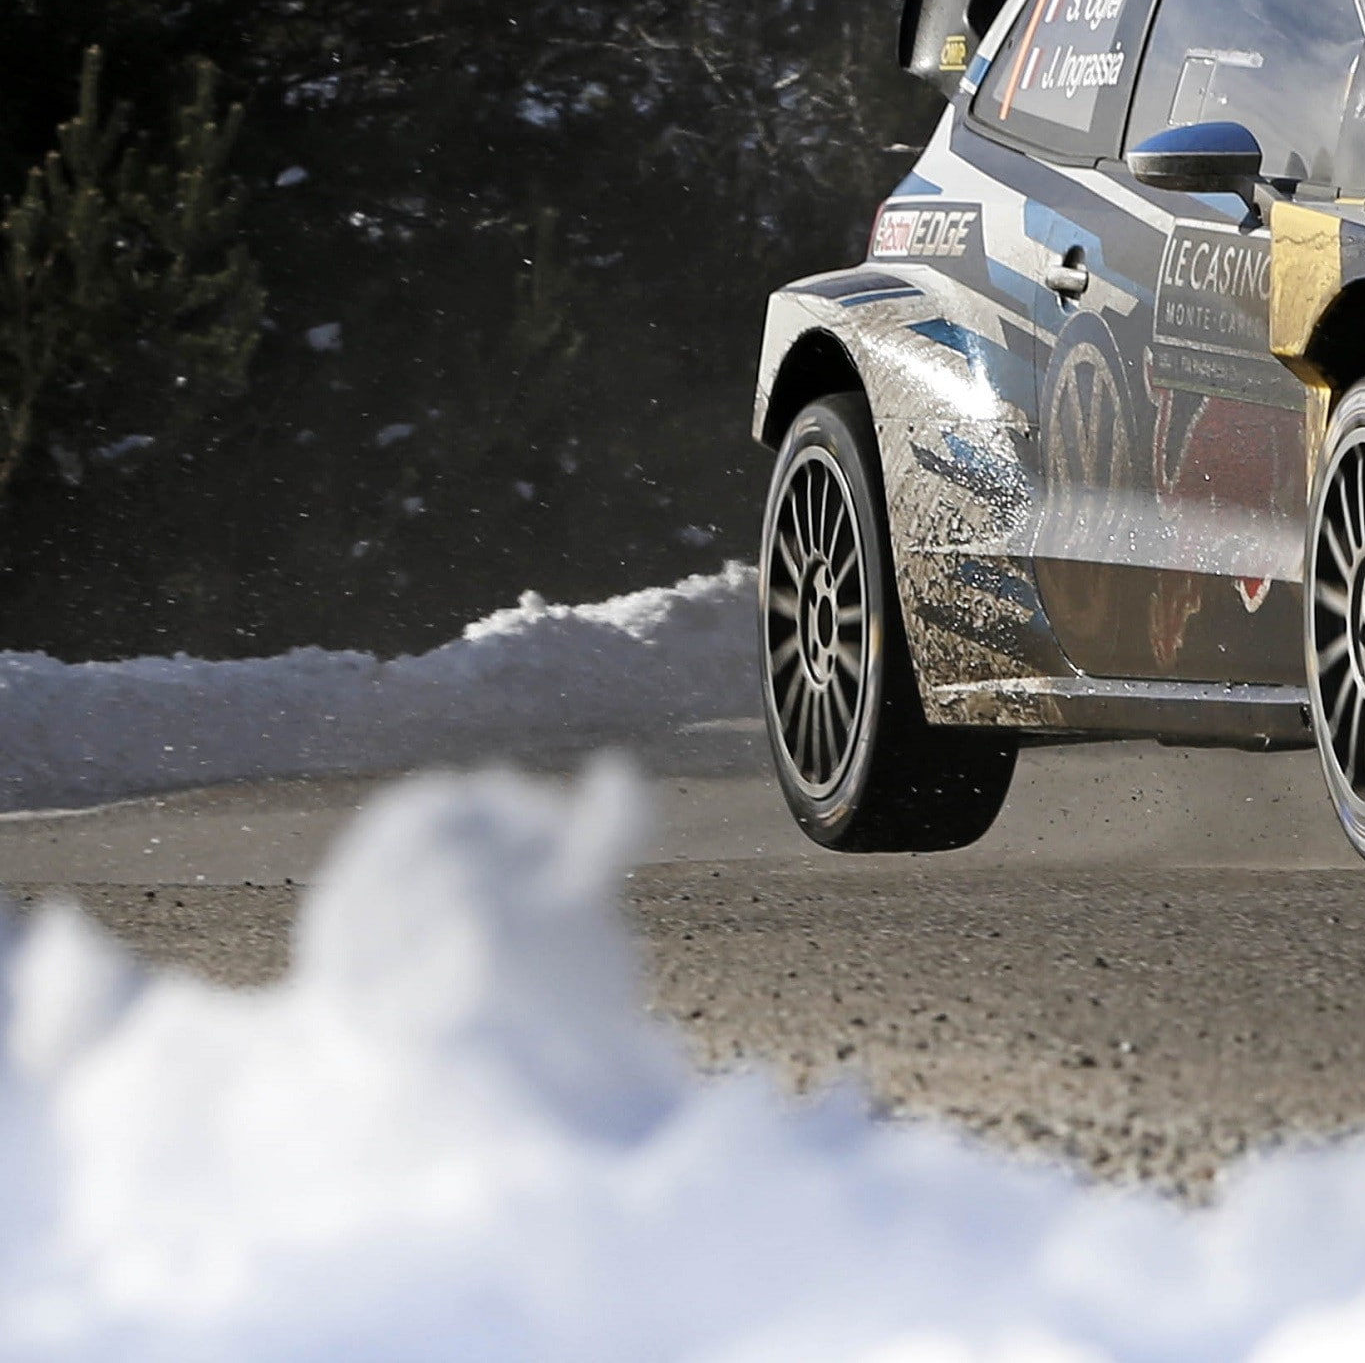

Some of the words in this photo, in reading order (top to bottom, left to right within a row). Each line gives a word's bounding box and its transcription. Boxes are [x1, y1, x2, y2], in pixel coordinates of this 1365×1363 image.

[1041, 46, 1062, 89] J.
[1059, 41, 1125, 99] Ingrassia
[909, 210, 977, 256] EDGE
